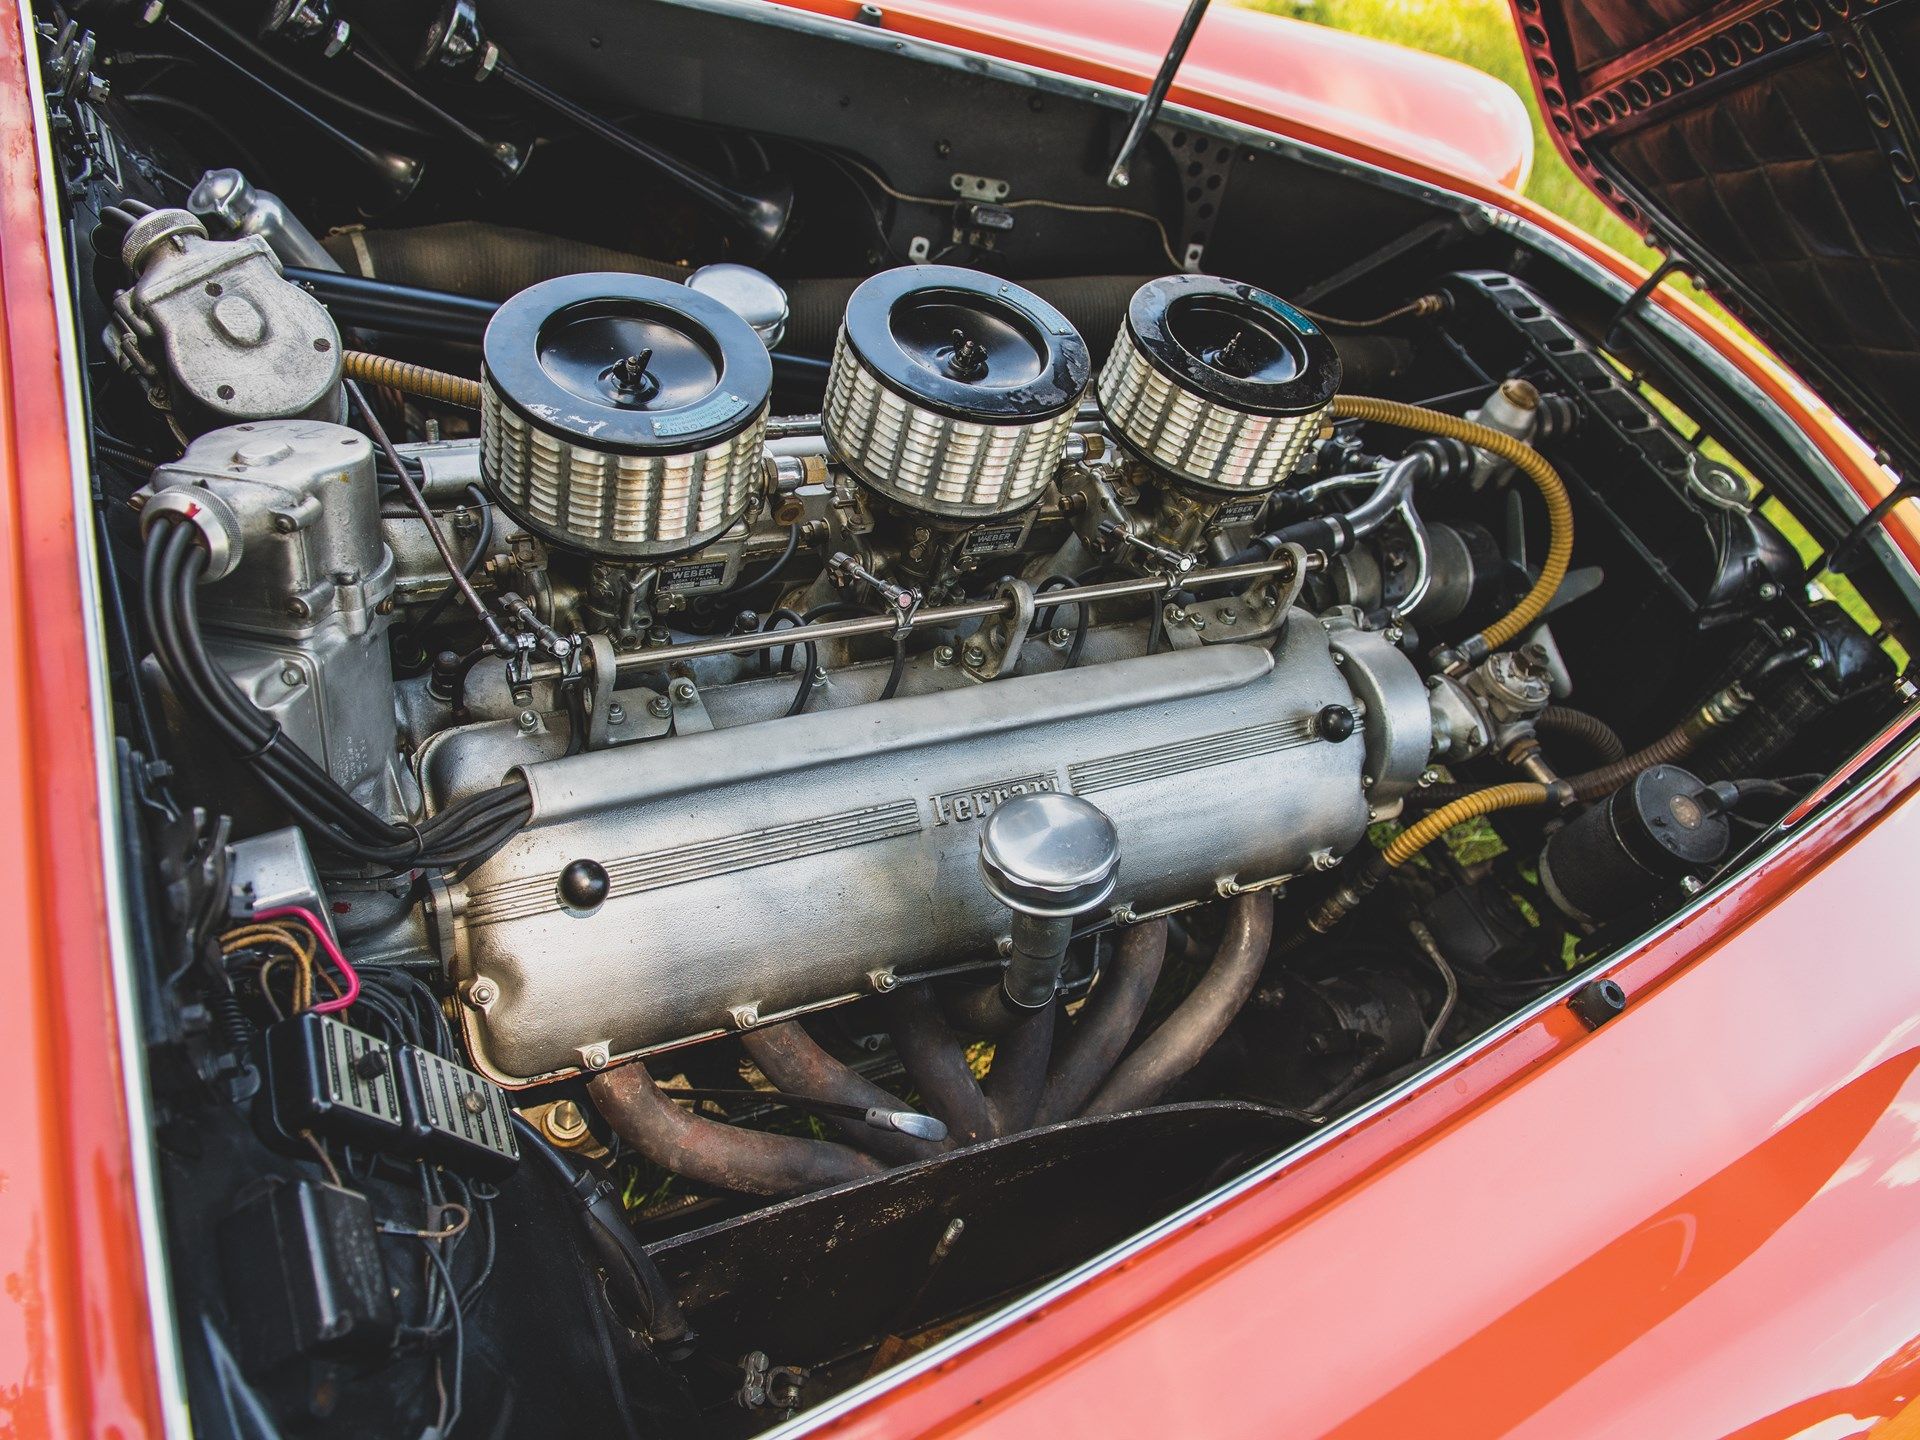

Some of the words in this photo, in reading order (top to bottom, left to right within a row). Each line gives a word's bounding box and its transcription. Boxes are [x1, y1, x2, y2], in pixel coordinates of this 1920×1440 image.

[1225, 505, 1254, 515] WEBER
[977, 533, 1011, 543] WEBER
[672, 568, 713, 580] WEBER
